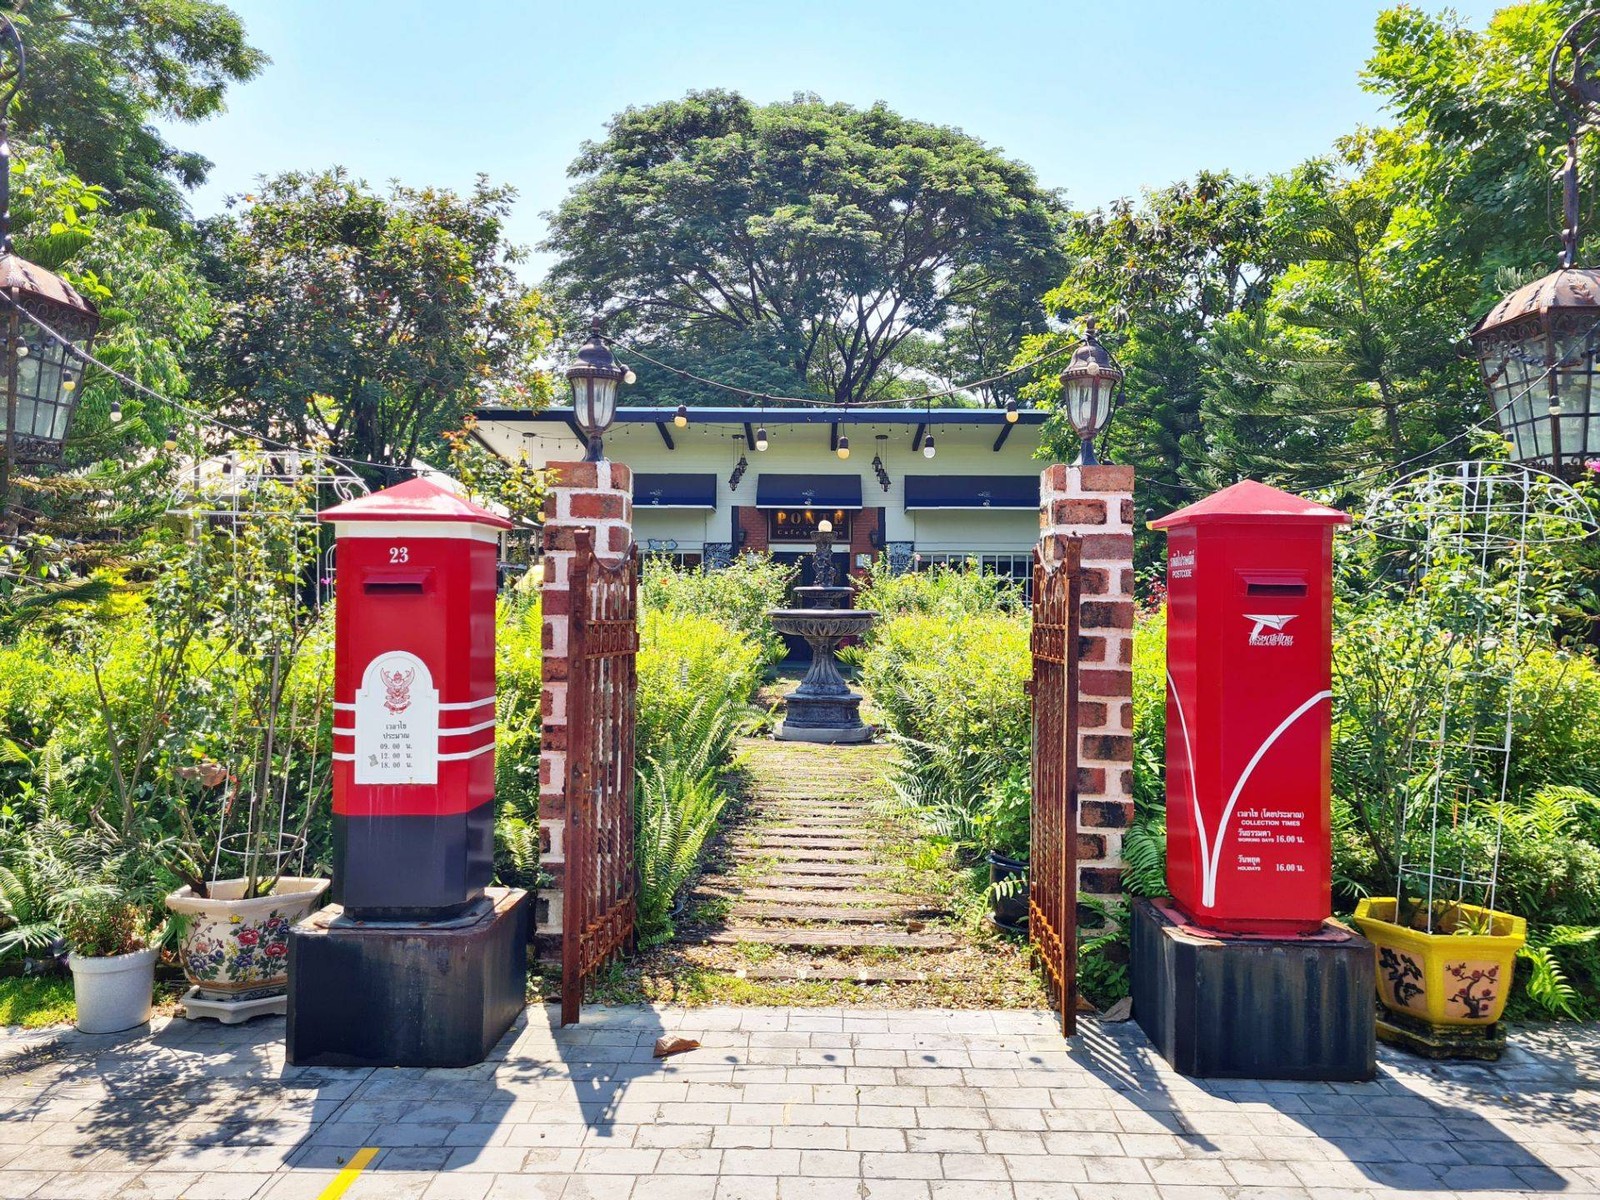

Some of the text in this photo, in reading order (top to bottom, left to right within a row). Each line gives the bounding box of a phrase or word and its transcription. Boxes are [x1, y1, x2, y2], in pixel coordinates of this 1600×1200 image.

[389, 546, 409, 564] 23
[1172, 569, 1193, 579] POSTCODE
[1237, 828, 1271, 837] วันธรรมดา
[1276, 835, 1295, 843] 16.00
[1237, 854, 1261, 866] วันหยุด
[1276, 863, 1295, 872] 16.00
